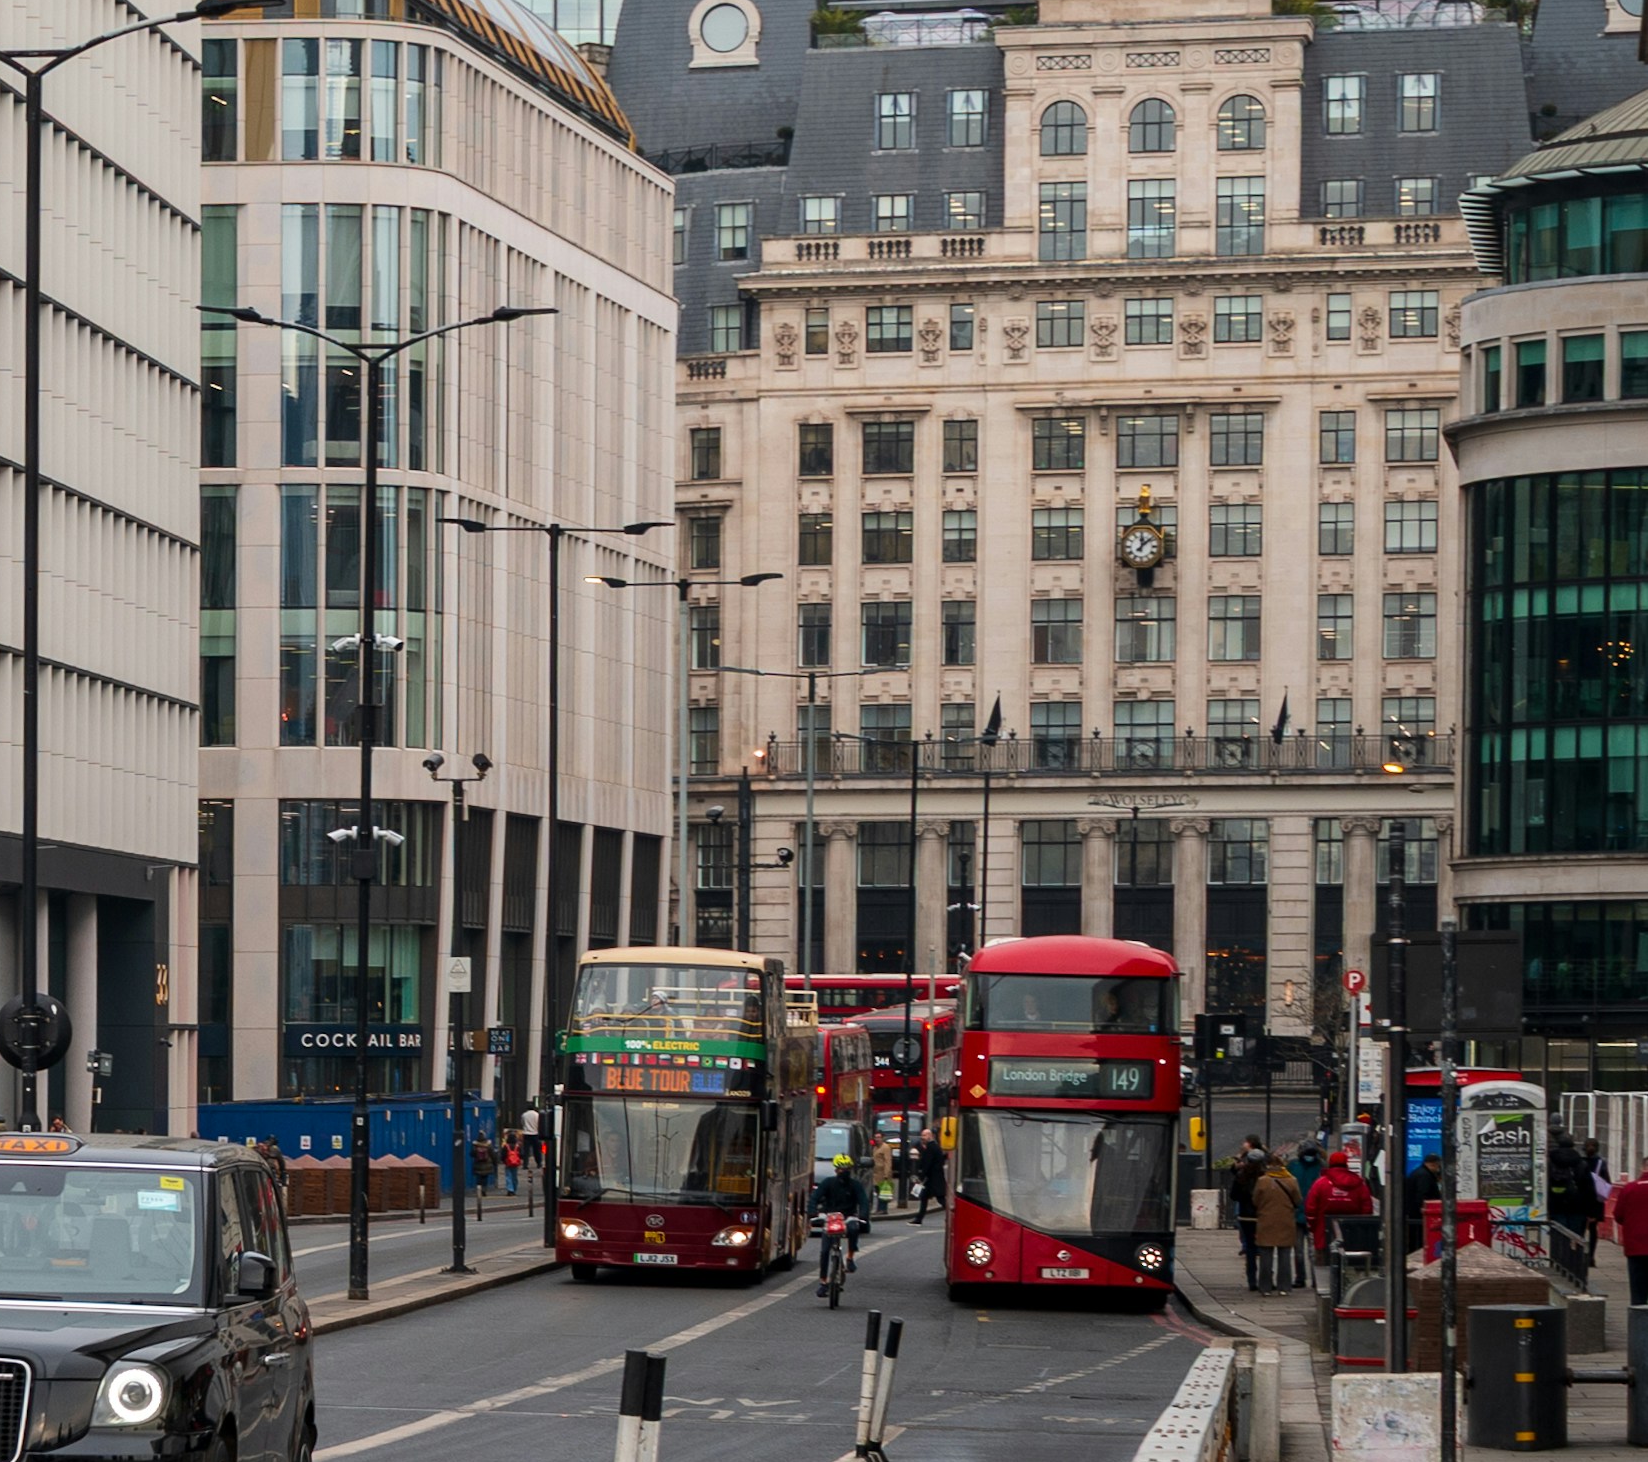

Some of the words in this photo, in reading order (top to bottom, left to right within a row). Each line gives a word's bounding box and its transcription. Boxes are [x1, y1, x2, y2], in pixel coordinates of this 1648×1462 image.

[1109, 794, 1180, 806] WOLSELEY
[1348, 972, 1361, 989] P
[301, 1033, 393, 1048] COCKAIL
[399, 1034, 422, 1048] BAR
[624, 1040, 652, 1049] 100%
[652, 1040, 700, 1051] ELECTRIC
[874, 1056, 890, 1067] 344
[605, 1066, 644, 1090] BLUE
[649, 1069, 690, 1092] TOUR
[1002, 1068, 1047, 1081] London
[1049, 1069, 1088, 1086] Bridge
[1111, 1068, 1140, 1091] 149
[1480, 1126, 1530, 1145] cash
